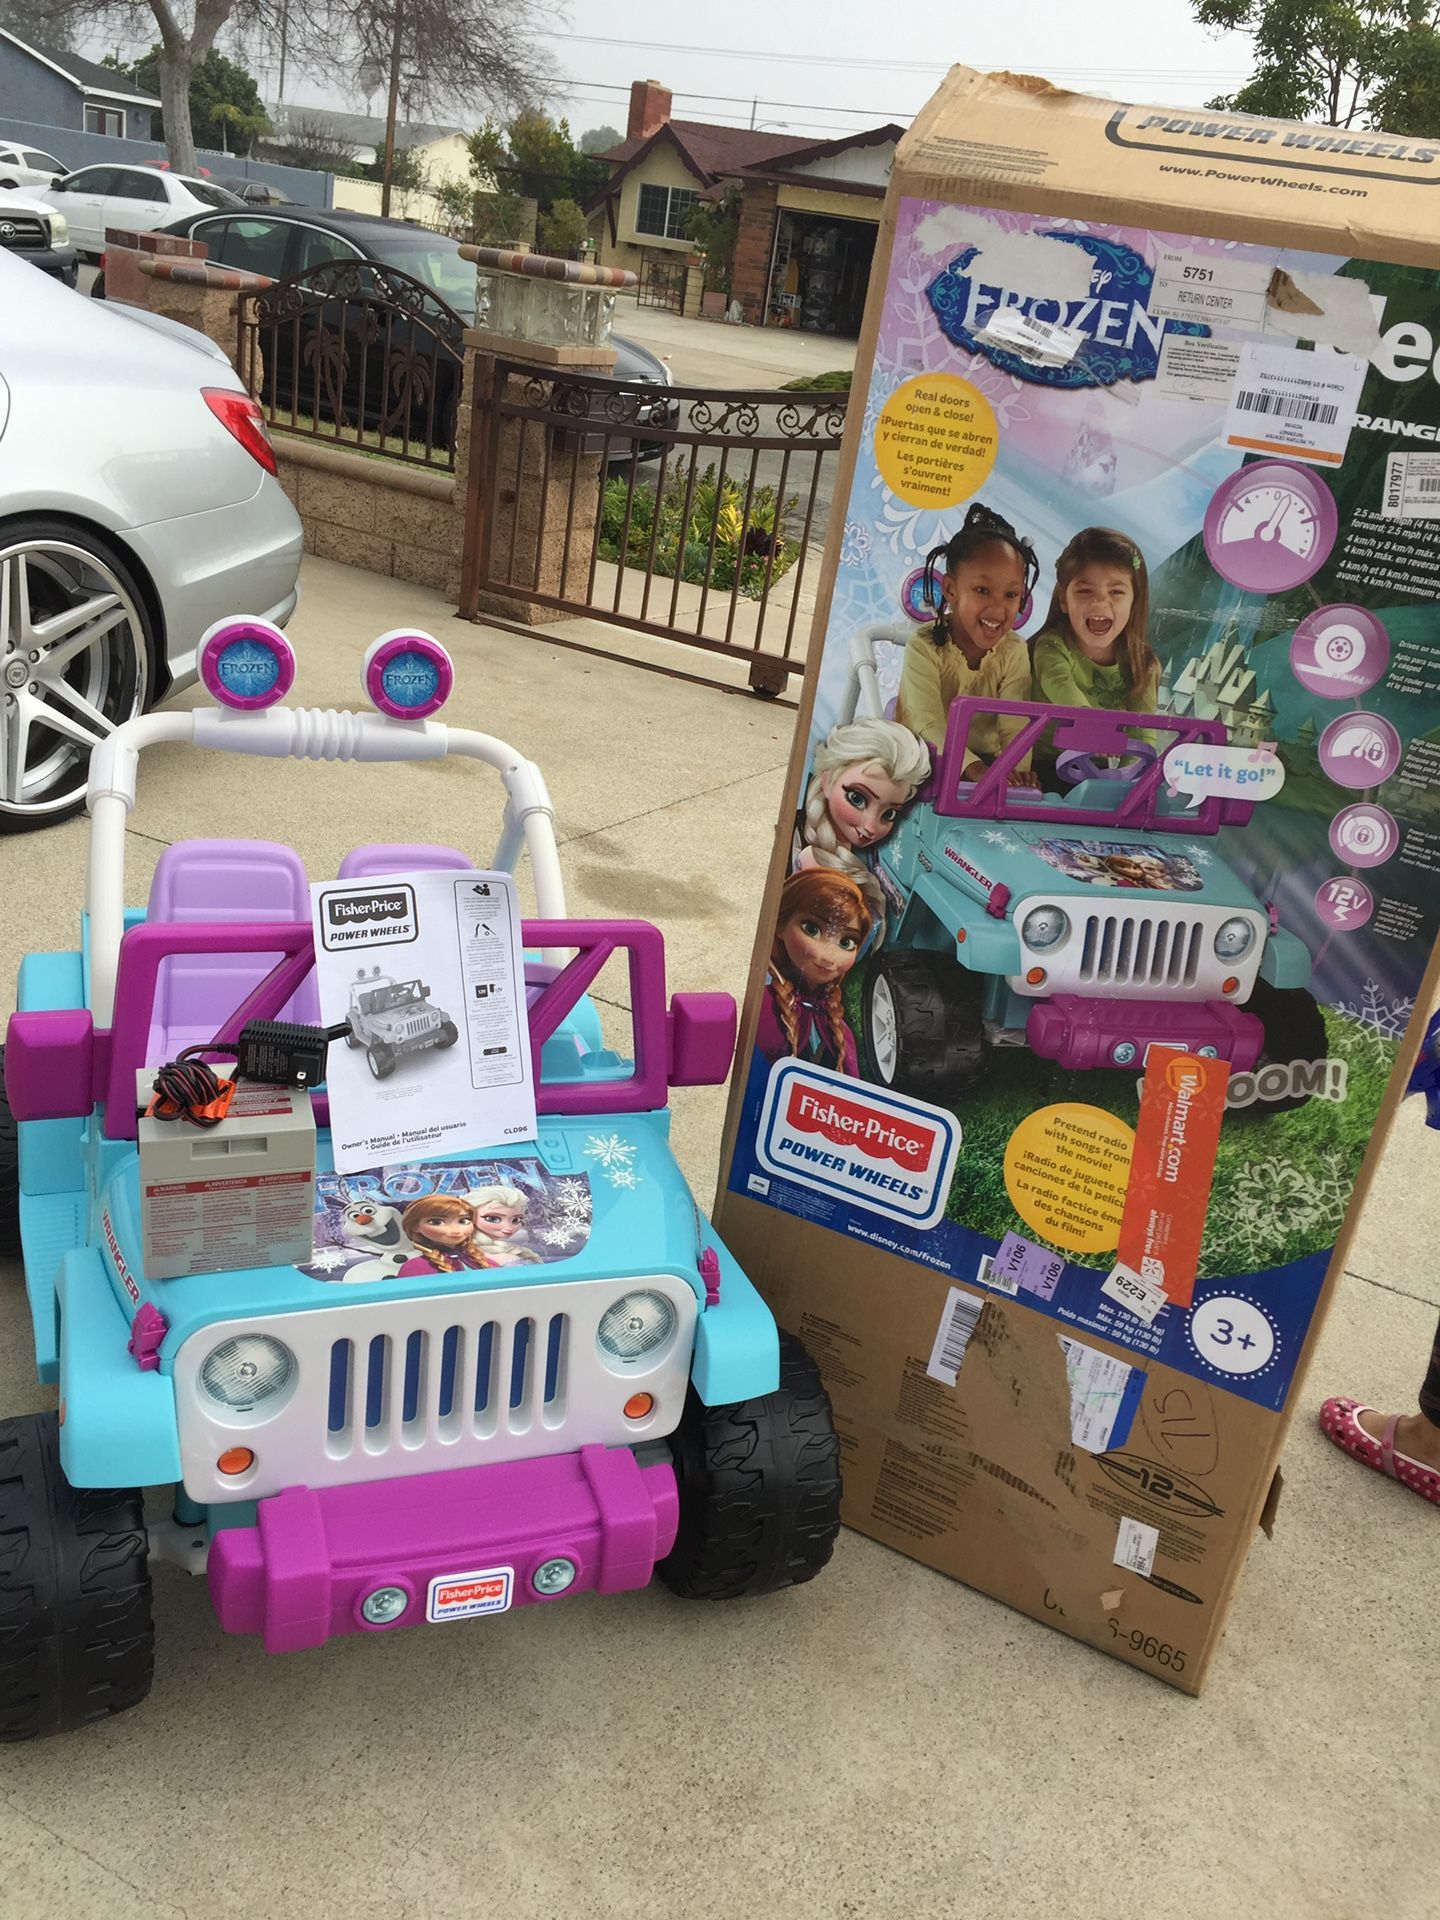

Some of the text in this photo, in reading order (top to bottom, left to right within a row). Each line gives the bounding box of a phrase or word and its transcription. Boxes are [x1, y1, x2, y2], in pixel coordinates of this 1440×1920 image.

[1136, 115, 1440, 164] POWER WHEELS
[1159, 164, 1368, 199] www.PowerWheels.com
[1183, 266, 1214, 282] 5751
[1178, 290, 1233, 309] RETURN CENTER
[915, 389, 970, 408] Real doors
[906, 403, 974, 423] open & close!
[881, 416, 992, 444] ¡Puertas que se abren
[1352, 413, 1440, 442] RANG
[883, 431, 986, 458] y cierran de verdad!
[897, 450, 964, 471] Les portières
[901, 480, 951, 496] vraiment!
[904, 466, 952, 483] s'ouvrent
[1387, 461, 1404, 508] 8017977
[1351, 518, 1433, 543] forward; 2.5 mph (4
[1353, 508, 1368, 517] 2.5
[1413, 520, 1423, 529] (4
[1347, 534, 1353, 542] 4
[1353, 535, 1377, 547] km/h
[1376, 541, 1384, 549] y
[1383, 541, 1392, 549] 8
[1391, 542, 1415, 554] km/h
[1339, 559, 1346, 568] 4
[1346, 561, 1369, 572] km/h
[1369, 567, 1379, 575] et
[1380, 568, 1387, 576] 8
[1386, 569, 1409, 581] km/h
[1343, 545, 1351, 553] 4
[1350, 546, 1373, 557] km/h
[1395, 556, 1407, 565] en
[1407, 559, 1440, 571] reversa
[1362, 576, 1370, 584] 4
[1369, 577, 1393, 589] km/h
[1393, 583, 1435, 599] maximum
[1399, 640, 1420, 651] Drives
[221, 662, 275, 675] FROZEN
[1410, 658, 1427, 666] para
[386, 673, 435, 686] FROZEN
[1401, 685, 1422, 695] gazon
[1404, 678, 1424, 687] rouler
[1218, 763, 1232, 779] it
[944, 845, 993, 891] WRANGLER
[334, 900, 402, 917] Fisher-Price
[330, 925, 410, 942] POWER WHEELS
[1225, 1065, 1341, 1103] OOM!
[341, 1139, 369, 1150] Owner's
[370, 1134, 396, 1144] Manual
[401, 1127, 428, 1138] Manual
[428, 1125, 440, 1133] del
[440, 1121, 467, 1132] usuario
[799, 1094, 920, 1156] Fisher-Price
[1053, 1117, 1128, 1150] Pretend radio
[1165, 1074, 1198, 1183] Walmart.com
[370, 1140, 391, 1150] Guide
[402, 1131, 443, 1145] l'utilisateur
[1044, 1127, 1130, 1165] with songs from
[778, 1137, 924, 1201] POWER WHEELS
[1023, 1150, 1116, 1191] ¡Radio de juguete
[1056, 1144, 1113, 1172] the movie!
[316, 1159, 548, 1214] FROZEN
[1014, 1161, 1125, 1208] canciones de la pelícu
[1016, 1179, 1100, 1218] La radio factice
[1033, 1199, 1104, 1233] des chansons
[1045, 1216, 1087, 1239] du film!
[847, 1223, 952, 1271] www.disney.com/frozen
[1008, 1243, 1026, 1273] V106
[1042, 1261, 1061, 1291] V106
[1115, 1275, 1146, 1301] E229
[1057, 1307, 1160, 1355] Poids maximal 59 kg (130 lb)
[1099, 1303, 1116, 1317] Max.
[1117, 1310, 1132, 1323] 130
[1131, 1315, 1140, 1325] lb
[1151, 1323, 1165, 1336] kg)
[1114, 1318, 1124, 1330] 59
[1124, 1323, 1135, 1335] kg
[1135, 1328, 1151, 1342] (130
[1151, 1334, 1162, 1345] lb)
[1210, 1318, 1256, 1350] 3+
[1140, 1467, 1175, 1501] 12
[439, 1583, 503, 1600] Fisher-Price
[437, 1599, 502, 1615] POWER WHEELS
